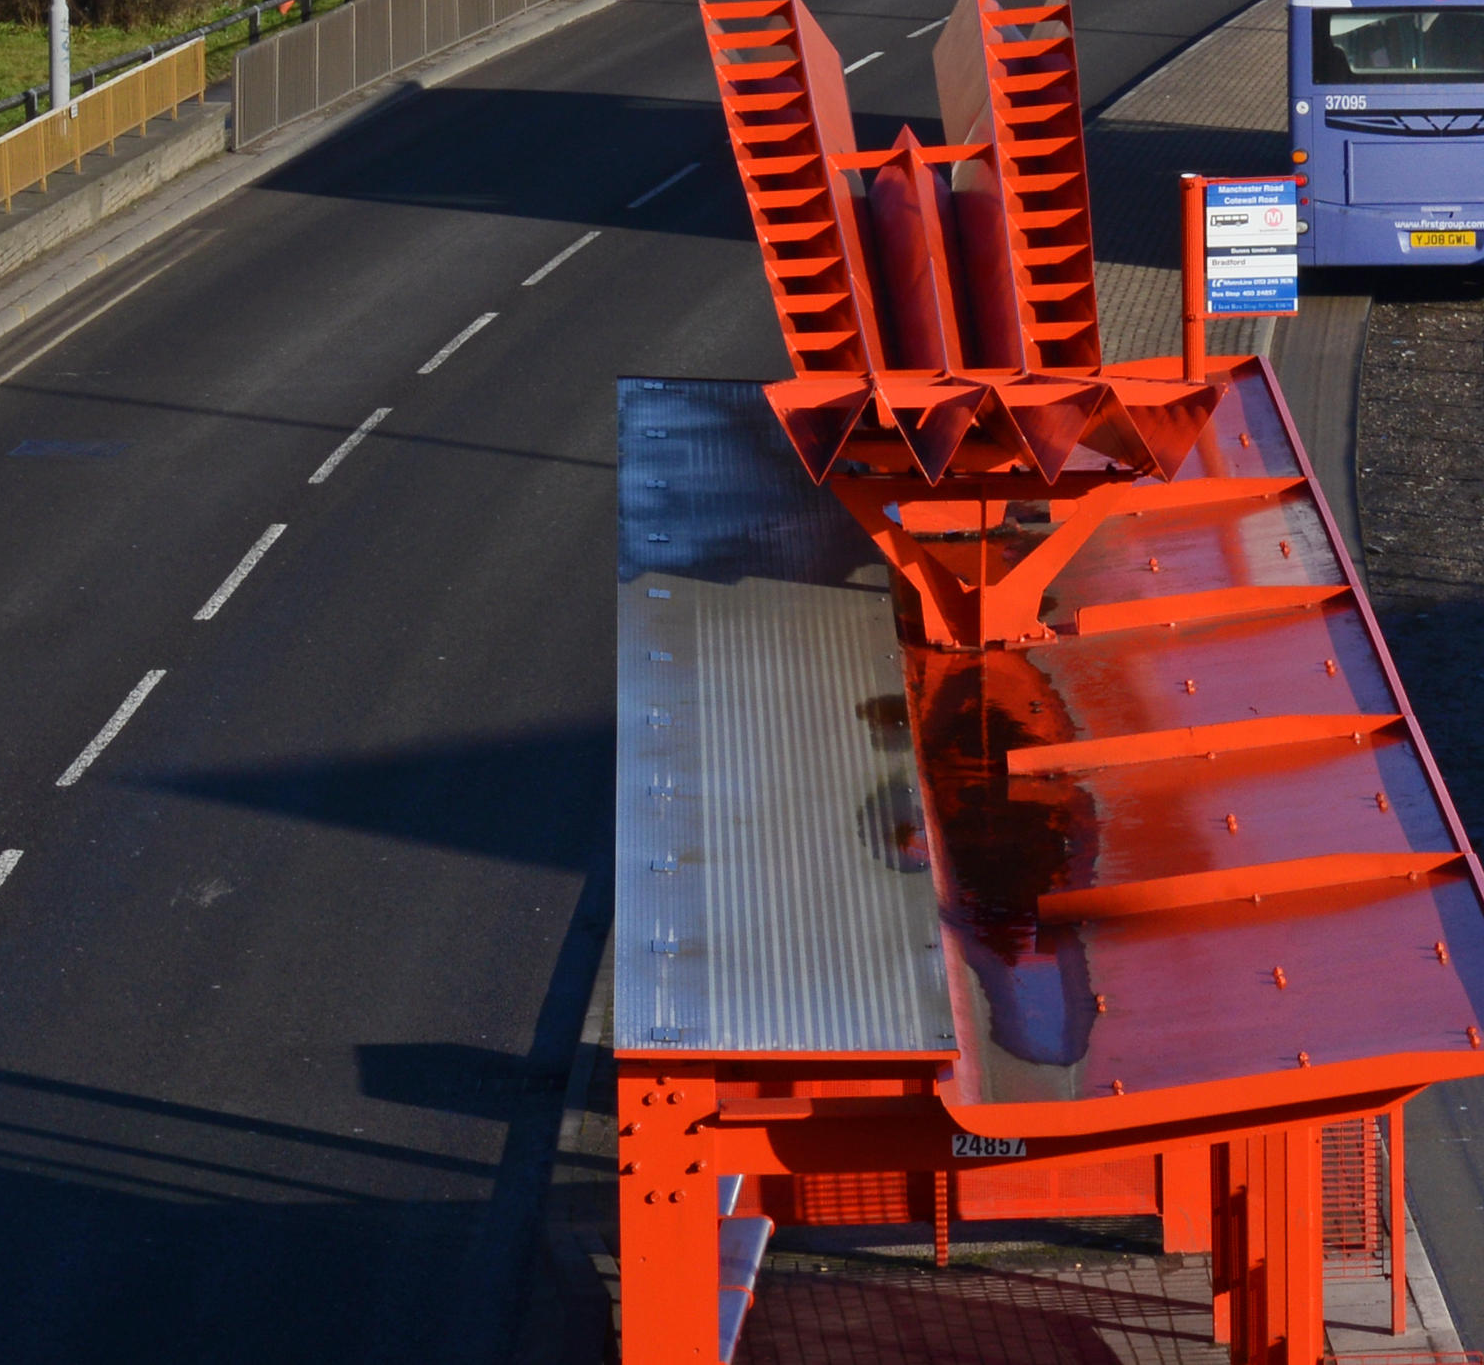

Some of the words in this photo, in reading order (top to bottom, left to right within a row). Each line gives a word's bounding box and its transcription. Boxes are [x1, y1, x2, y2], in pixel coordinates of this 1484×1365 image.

[1325, 95, 1367, 110] 37095
[1218, 185, 1262, 194] Manchester
[1263, 184, 1284, 193] Road
[1258, 195, 1278, 204] Road
[1417, 234, 1445, 244] YJ08
[1448, 233, 1470, 244] GWL
[955, 1135, 1025, 1156] 24857
